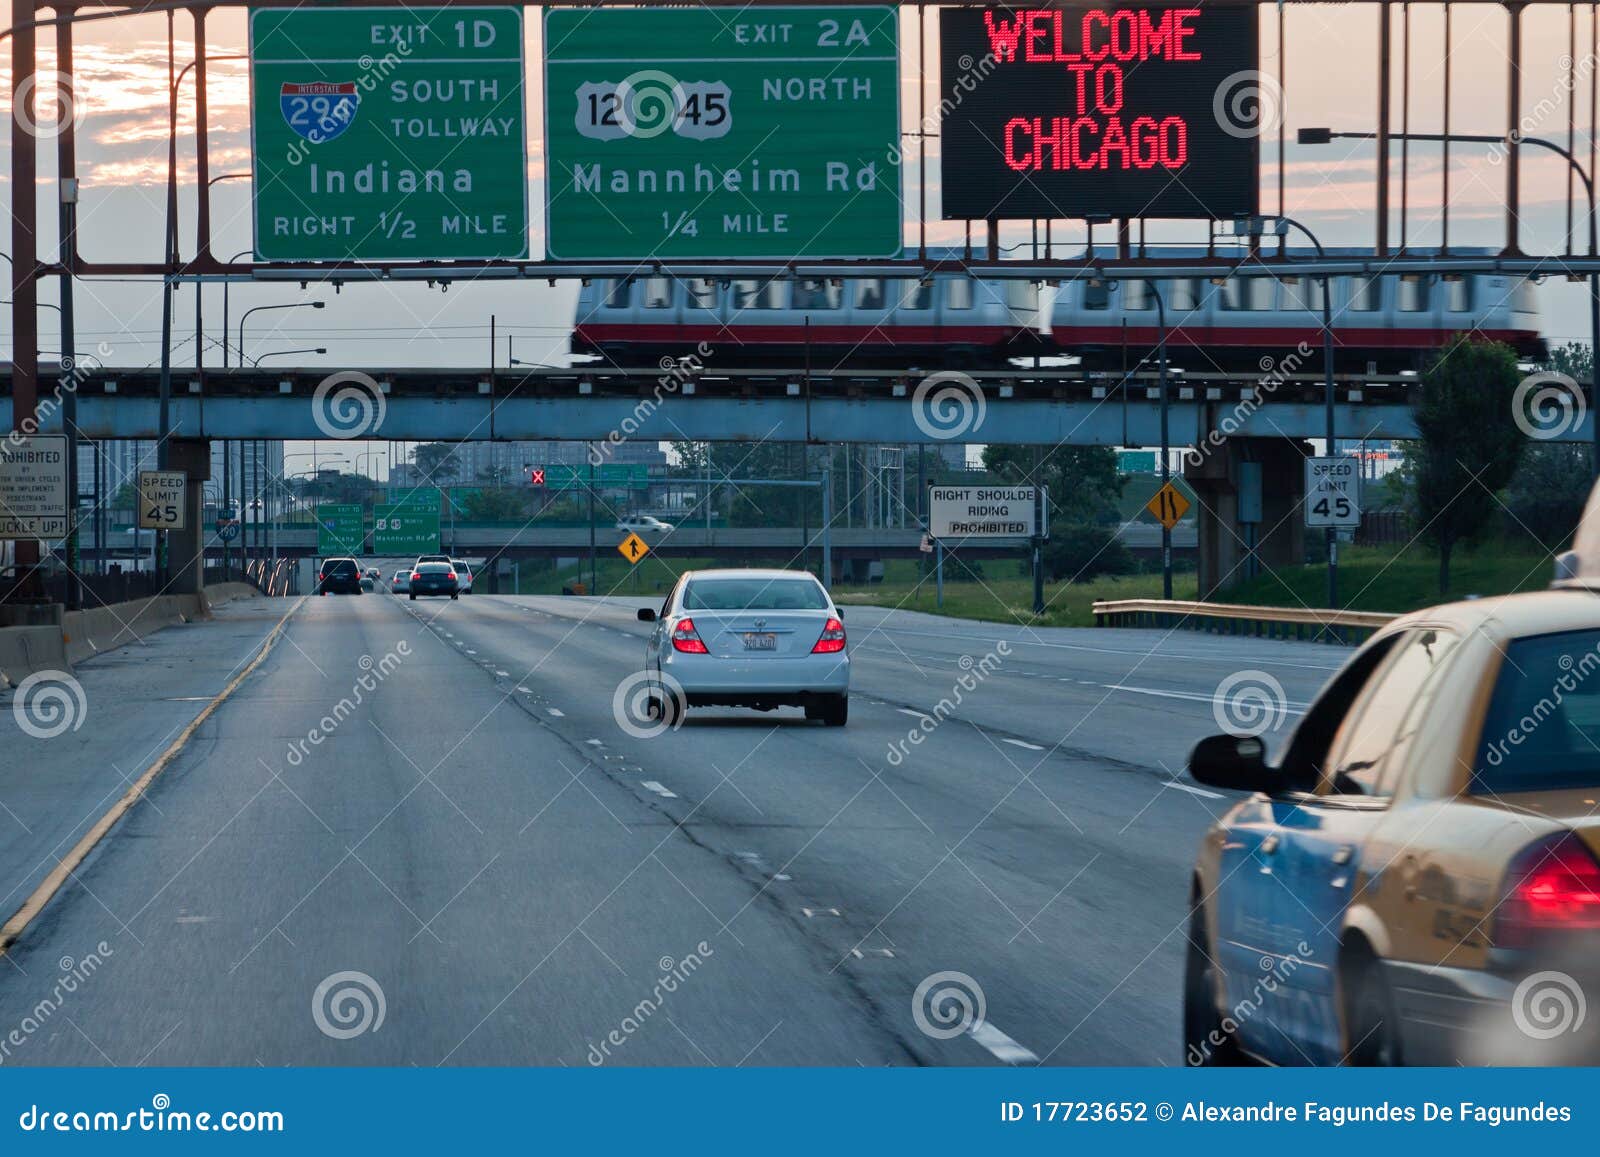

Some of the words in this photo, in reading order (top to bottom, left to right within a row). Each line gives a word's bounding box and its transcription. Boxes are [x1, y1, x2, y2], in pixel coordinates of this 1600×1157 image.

[371, 25, 428, 44] EXIT
[455, 20, 496, 48] 1D
[735, 24, 792, 43] EXIT
[816, 19, 870, 47] 2A
[984, 10, 1201, 62] WELCOME
[298, 85, 340, 94] INTERSTATE
[391, 79, 498, 102] SOUTH
[763, 78, 872, 100] NORTH
[1067, 63, 1123, 115] TO
[588, 93, 623, 126] 12
[677, 93, 727, 126] 45
[391, 118, 515, 137] TOLLWAY
[1004, 115, 1187, 171] CHICAGO
[311, 161, 472, 193] Indiana
[574, 160, 800, 193] Mannheim
[826, 161, 876, 192] Rd
[274, 216, 355, 236] RIGHT
[442, 215, 507, 235] MILE
[723, 214, 788, 233] MILE
[1314, 465, 1350, 476] SPEED
[143, 478, 183, 488] SPEED
[1318, 482, 1348, 492] LIMIT
[147, 492, 179, 501] LIMIT
[934, 490, 970, 501] RIGHT
[977, 490, 1035, 501] SHOULDE
[147, 506, 178, 522] 45
[968, 506, 1009, 517] RIDING
[1313, 498, 1350, 518] 45
[43, 521, 64, 533] UP!
[378, 520, 385, 528] 12
[392, 520, 400, 528] 45
[952, 523, 1024, 534] PROHIBITED
